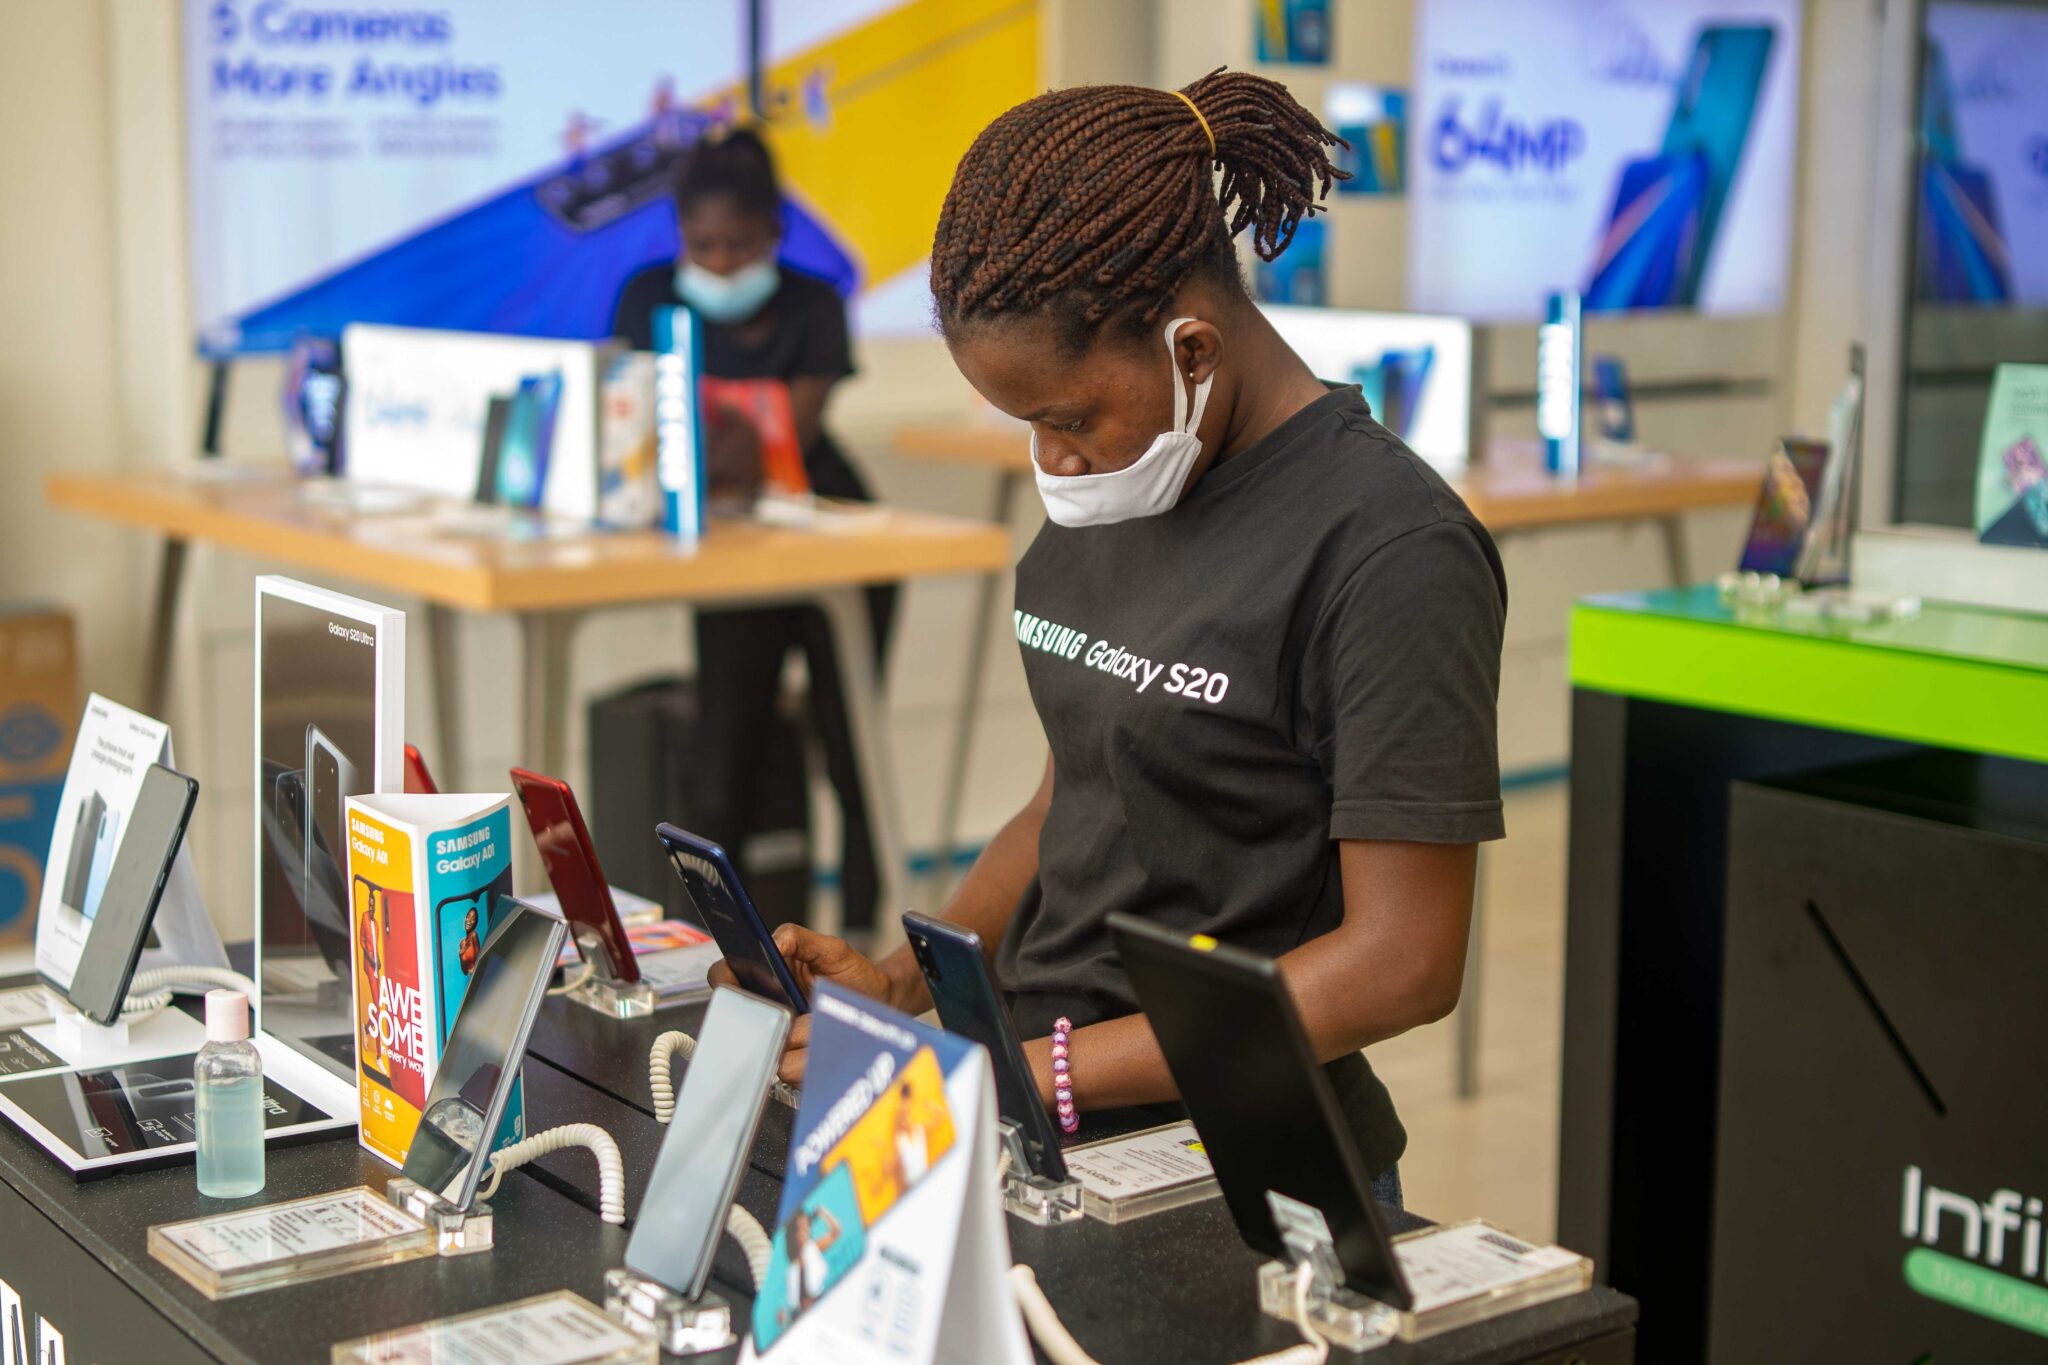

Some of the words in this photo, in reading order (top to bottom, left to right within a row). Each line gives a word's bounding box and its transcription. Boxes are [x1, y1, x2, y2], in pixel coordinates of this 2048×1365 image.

[250, 0, 453, 44] Cameras
[210, 58, 332, 96] More
[346, 54, 504, 107] Angles
[1428, 95, 1588, 173] 64MP
[328, 621, 350, 642] Galaxy
[349, 628, 361, 643] S20
[360, 631, 374, 647] Ultra
[1014, 608, 1089, 661] AMSUNG
[1085, 639, 1164, 693] Galaxy
[1163, 662, 1229, 704] S20
[351, 817, 385, 845] SAMSUNG
[352, 837, 376, 865] Galaxy
[376, 849, 389, 865] A01
[436, 826, 491, 855] SAMSUNG
[436, 851, 481, 875] Galaxy
[482, 843, 495, 862] A01
[379, 975, 423, 1028] AWE
[368, 1002, 426, 1062] SOME
[380, 1042, 387, 1056] in
[387, 1049, 407, 1071] every
[408, 1055, 425, 1078] way
[1902, 1163, 2048, 1282] Infi
[1931, 1260, 1978, 1299] The
[1984, 1278, 2048, 1325] futur
